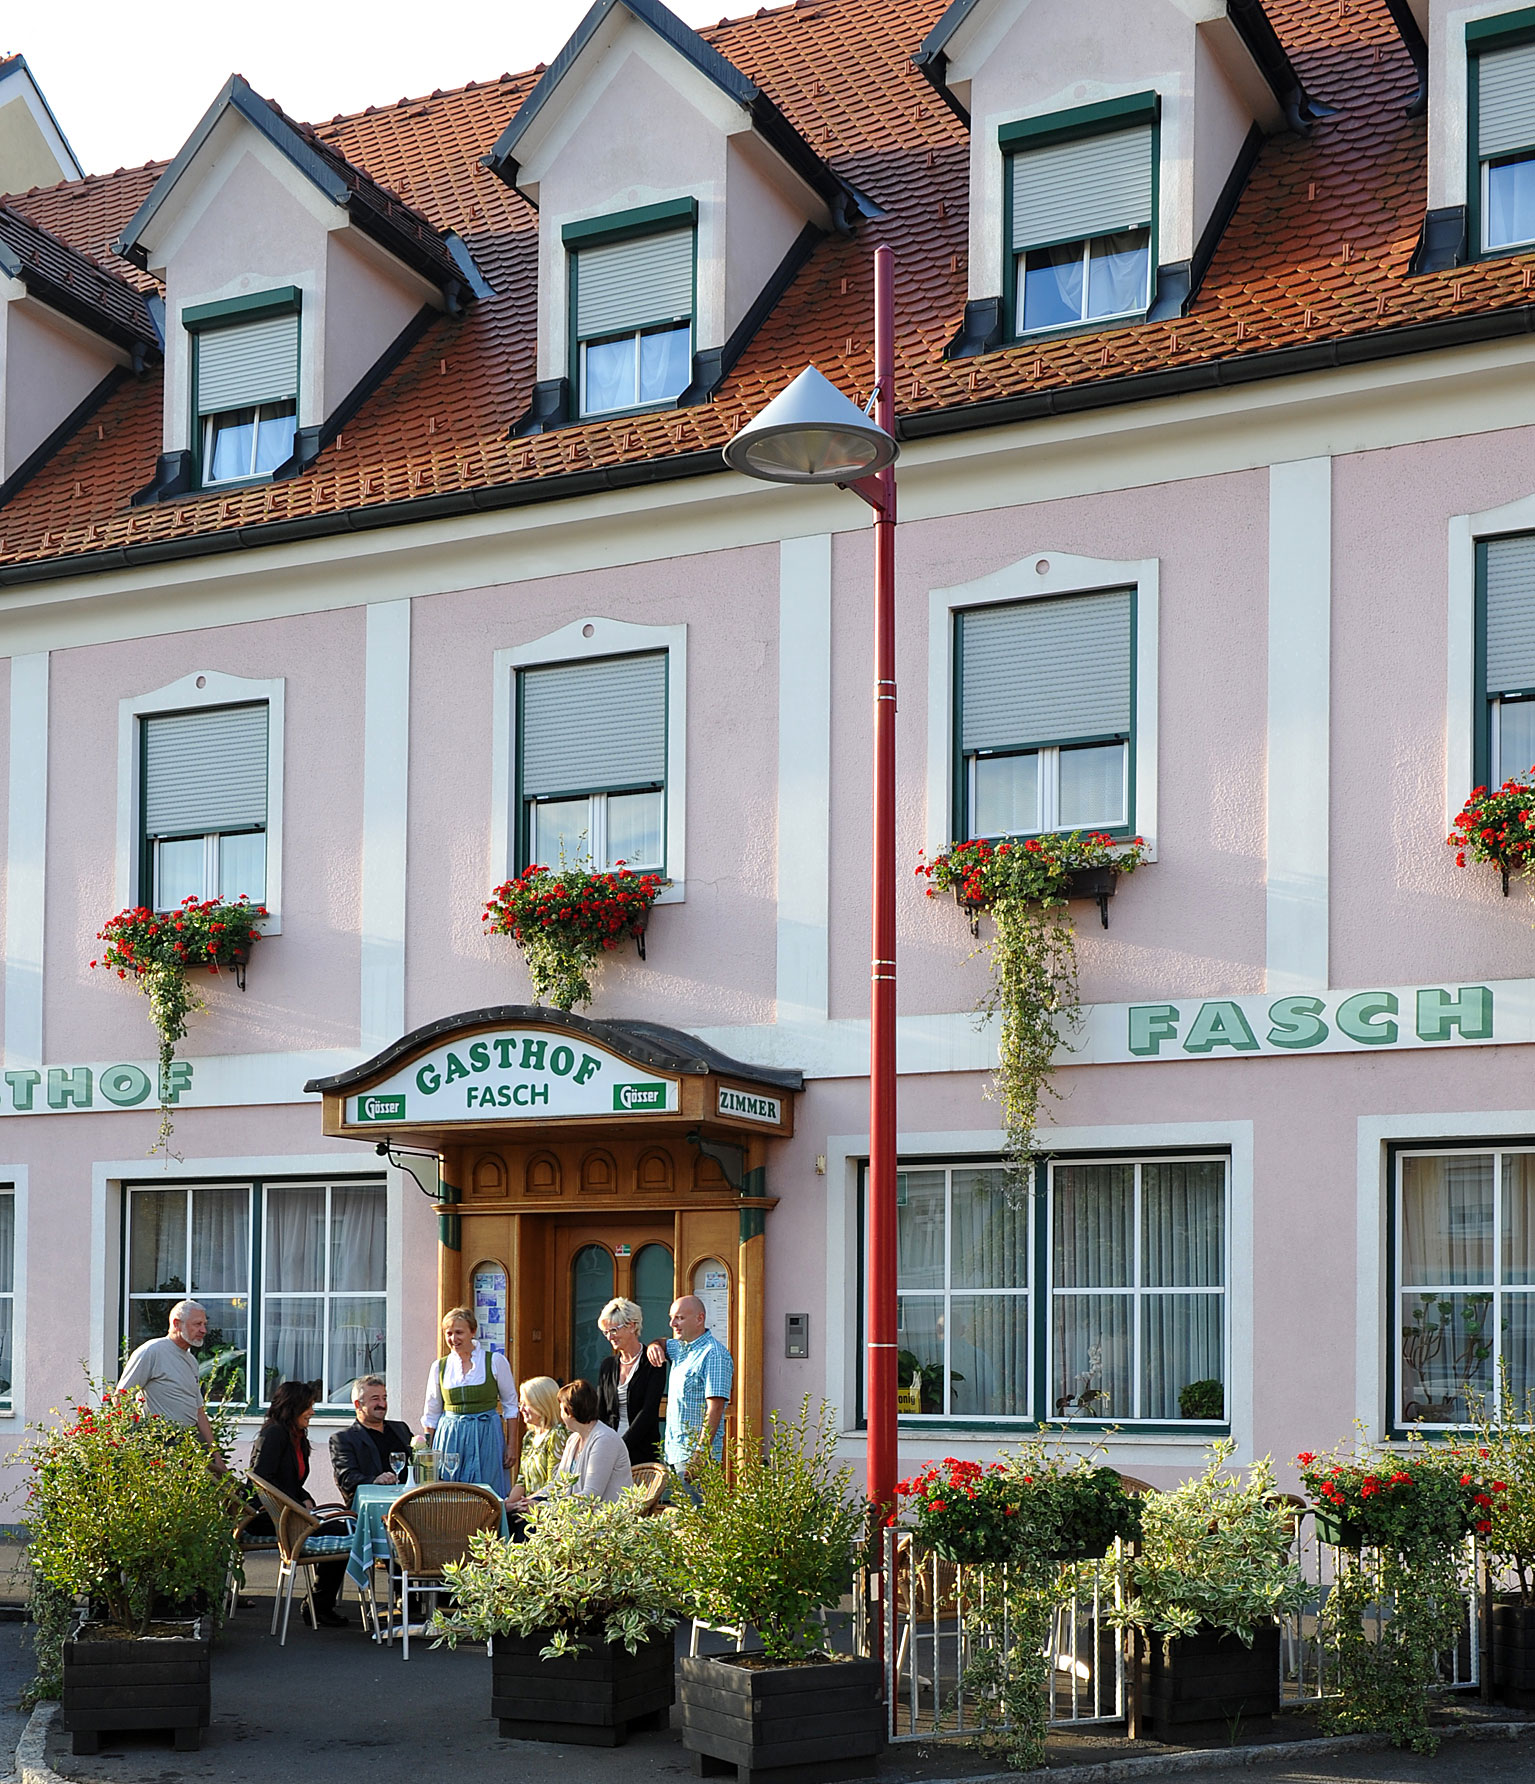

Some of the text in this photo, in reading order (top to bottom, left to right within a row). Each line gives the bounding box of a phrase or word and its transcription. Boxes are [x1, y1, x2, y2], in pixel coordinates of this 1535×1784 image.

[1128, 986, 1494, 1056] FASCH
[416, 1037, 602, 1095] GASTHOF
[0, 1061, 194, 1110] THOF
[467, 1083, 549, 1108] FASCH
[620, 1085, 660, 1109] Gösser
[365, 1097, 400, 1119] Gösser
[720, 1091, 776, 1119] ZIMMER
[898, 1392, 916, 1405] onig
